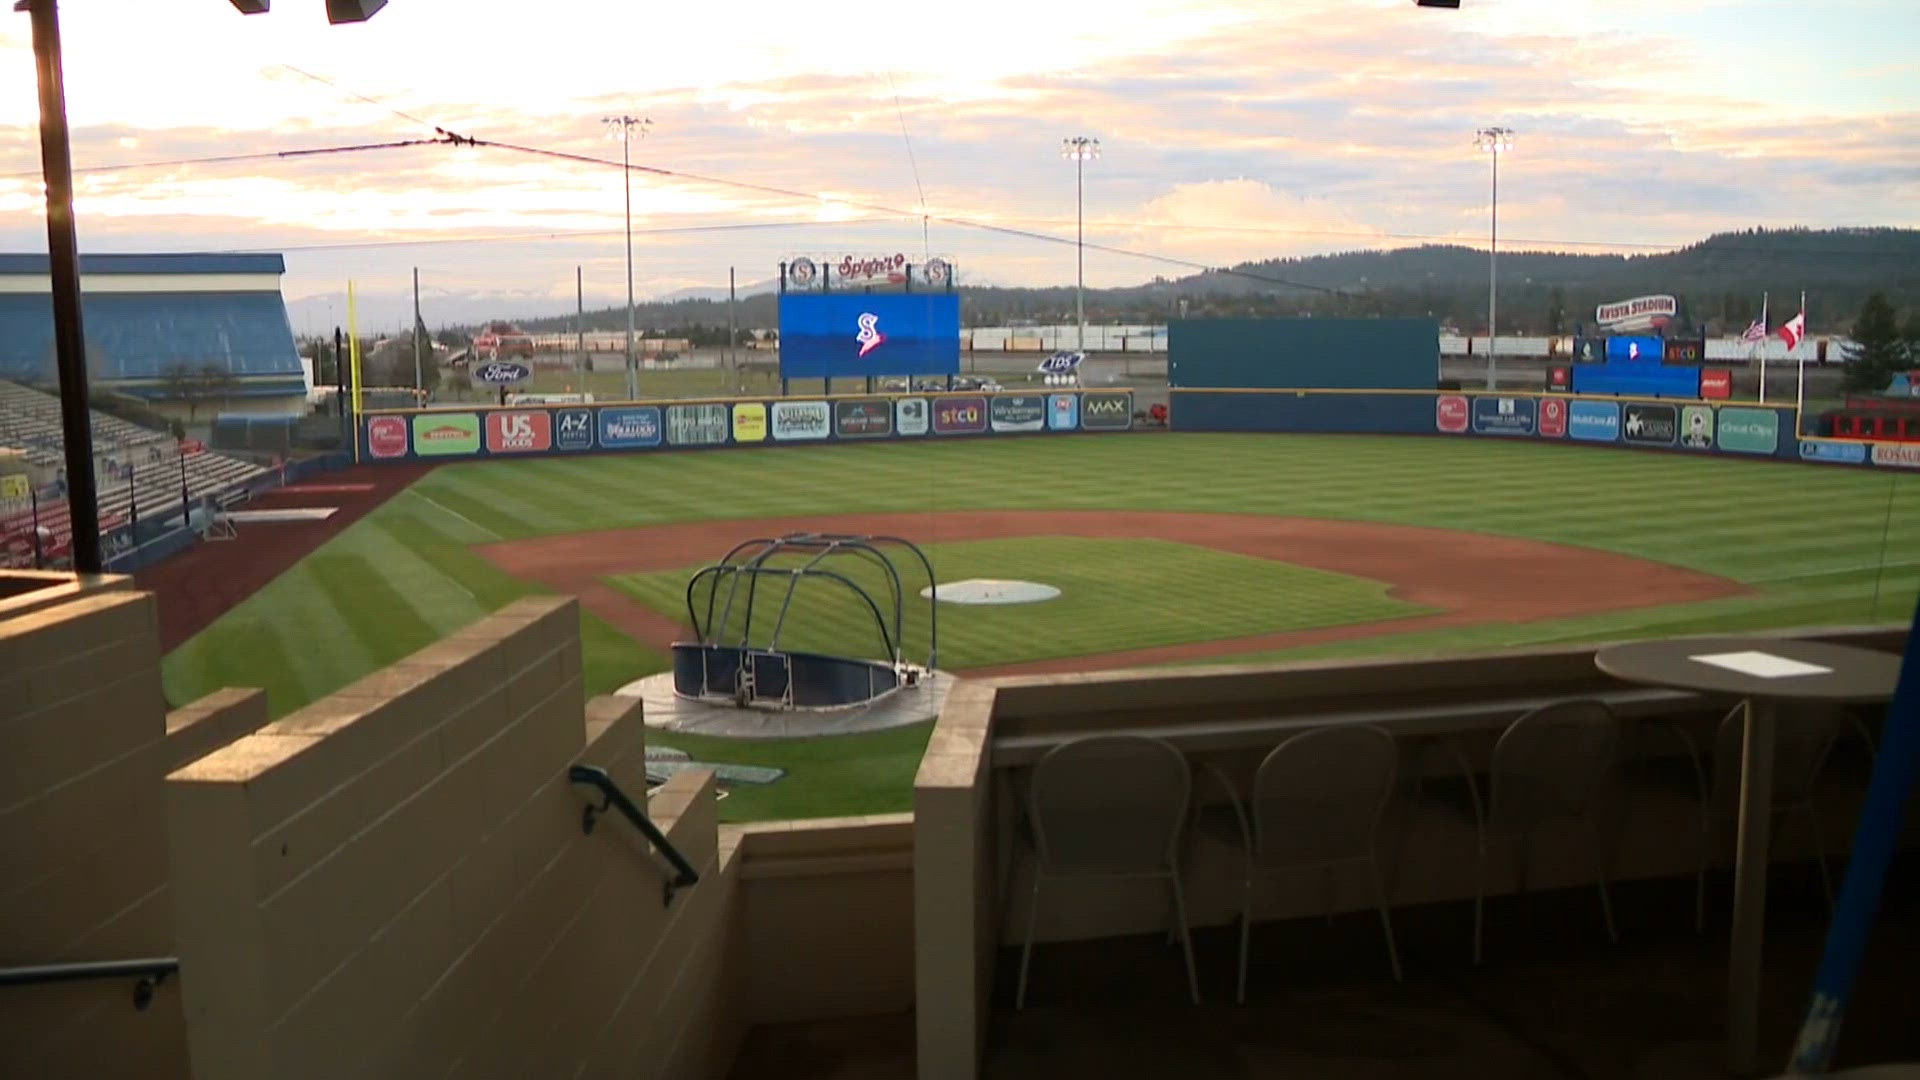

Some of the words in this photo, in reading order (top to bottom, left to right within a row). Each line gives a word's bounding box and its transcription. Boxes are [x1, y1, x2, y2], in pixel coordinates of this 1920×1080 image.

[1599, 305, 1630, 321] AVISTA
[1631, 298, 1673, 314] STADIUM
[857, 312, 879, 343] S
[1050, 355, 1073, 370] TDS
[484, 364, 520, 380] Ford
[1088, 399, 1124, 415] MAX
[560, 413, 588, 432] A-Z
[1721, 422, 1747, 434] Great
[502, 439, 533, 449] FOODS
